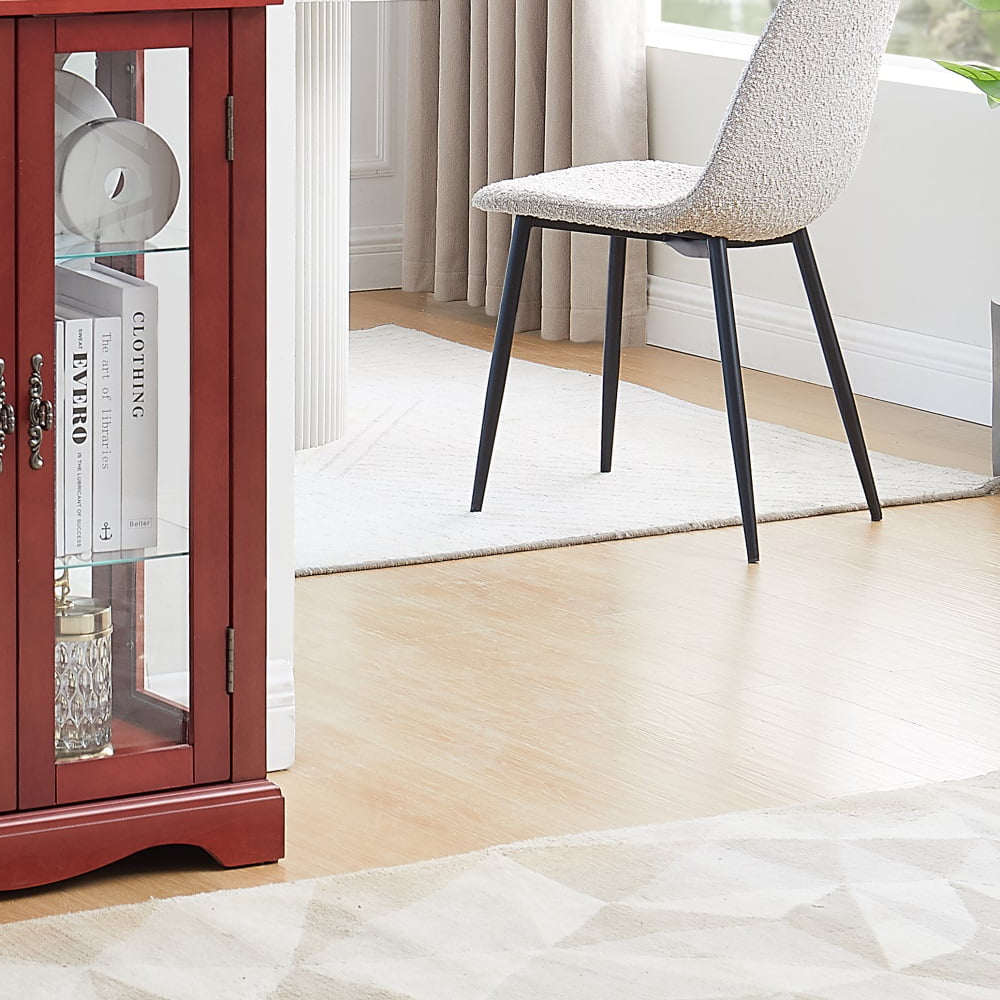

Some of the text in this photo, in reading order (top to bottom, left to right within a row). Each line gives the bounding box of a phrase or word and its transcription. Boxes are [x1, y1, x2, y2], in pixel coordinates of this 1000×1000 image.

[72, 352, 88, 445] EVERO
[101, 332, 112, 470] The art of libraries
[132, 311, 145, 419] CLOTHING
